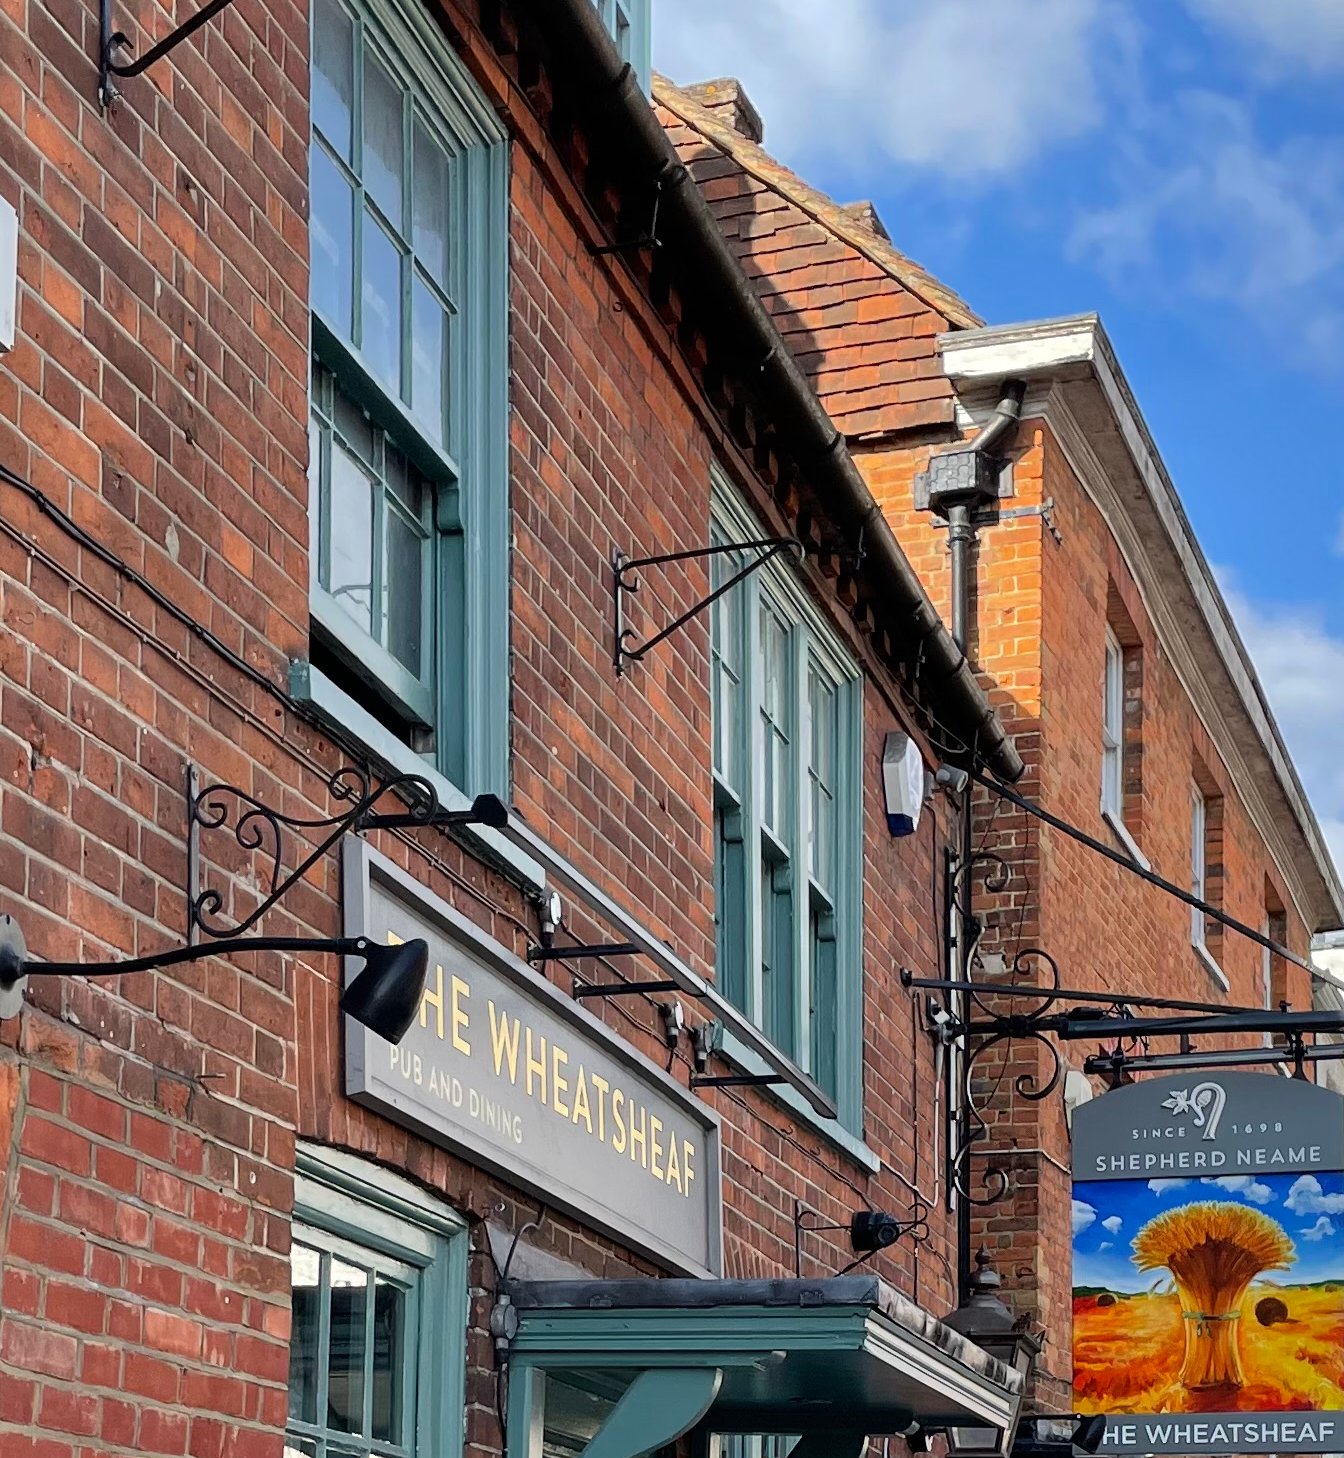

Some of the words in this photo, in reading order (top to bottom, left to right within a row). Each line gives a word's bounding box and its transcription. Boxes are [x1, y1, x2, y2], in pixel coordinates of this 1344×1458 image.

[389, 1044, 423, 1087] PUB
[428, 1066, 463, 1108] AND
[468, 1087, 523, 1144] DINING
[487, 999, 695, 1198] WHEATSHEAF
[1131, 1126, 1187, 1140] SINCE
[1231, 1122, 1284, 1135] 1698
[1095, 1151, 1227, 1172] SHEPHERD
[1236, 1145, 1322, 1166] NEAME
[1102, 1425, 1137, 1445] HE
[1145, 1421, 1336, 1445] WHEATSHEAF
